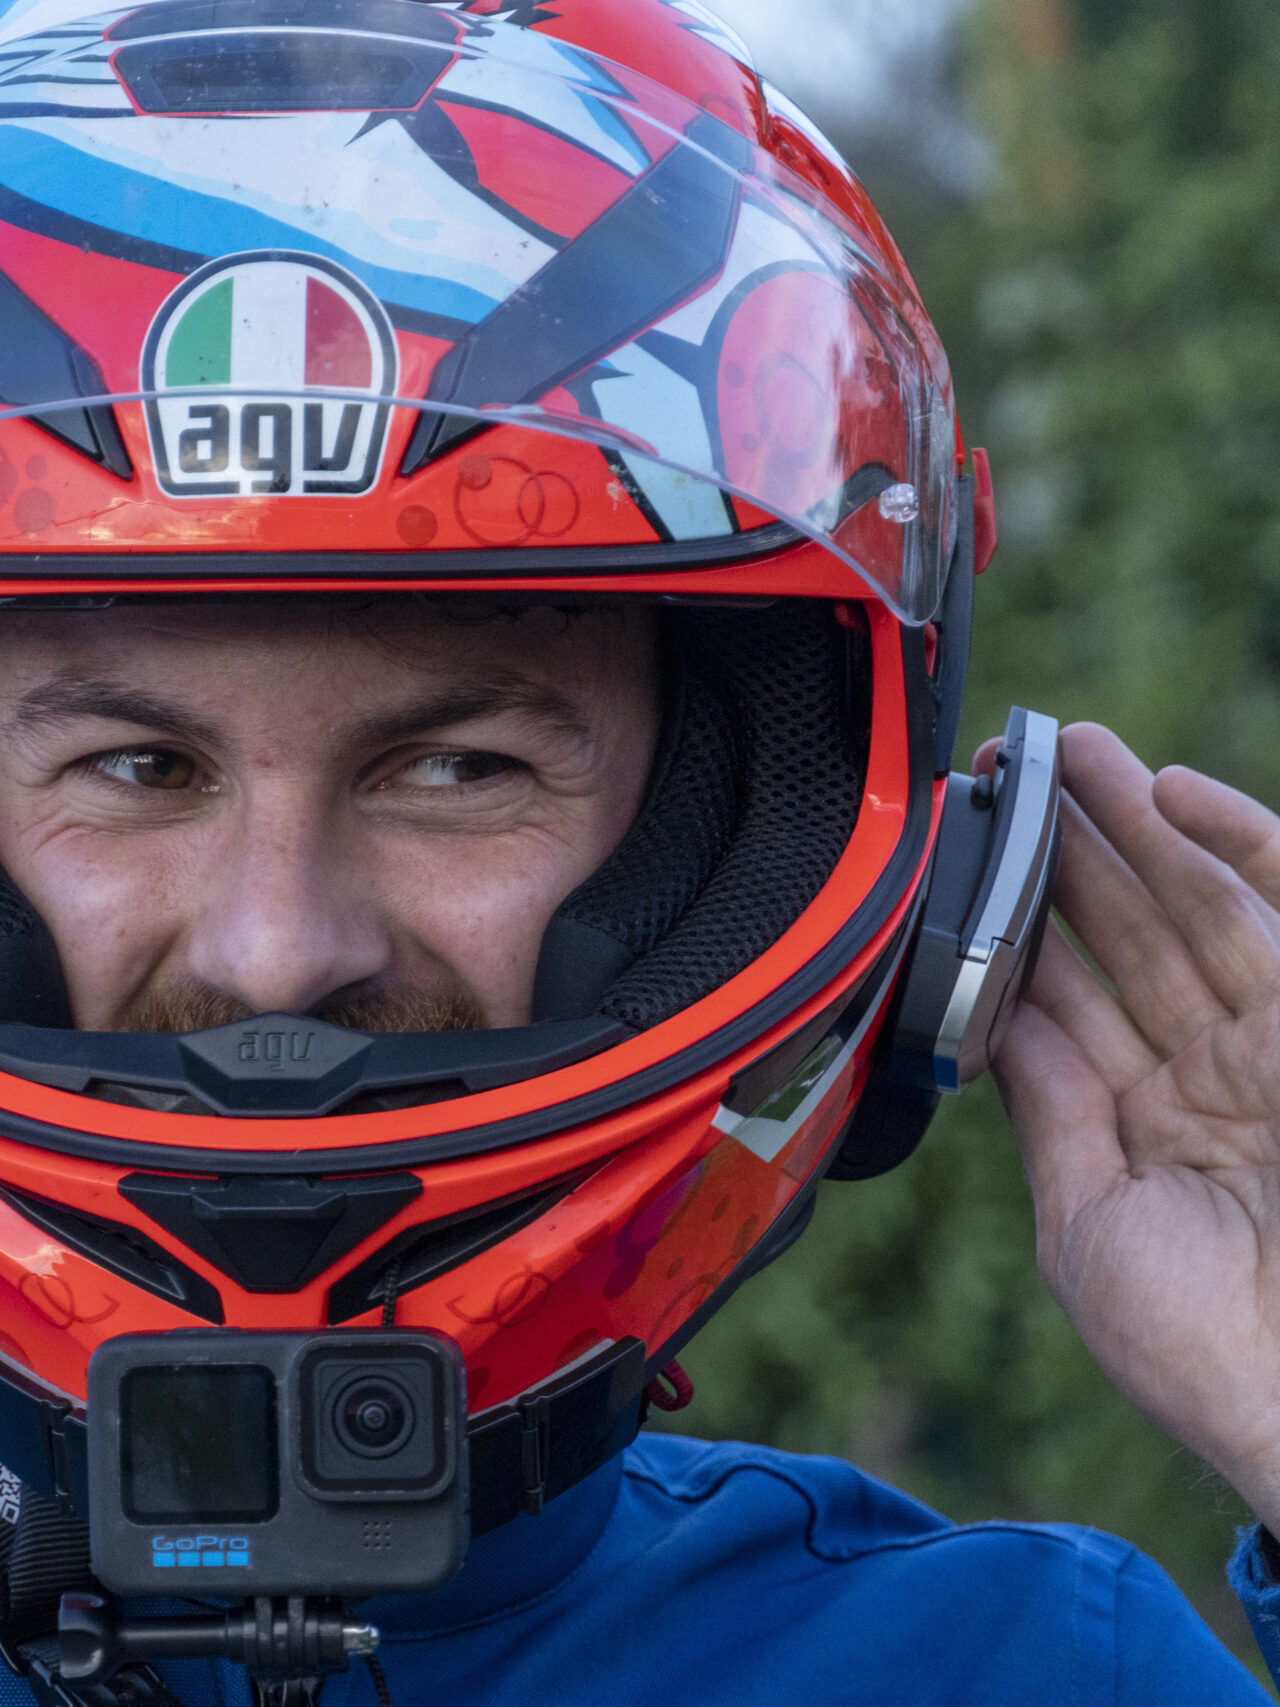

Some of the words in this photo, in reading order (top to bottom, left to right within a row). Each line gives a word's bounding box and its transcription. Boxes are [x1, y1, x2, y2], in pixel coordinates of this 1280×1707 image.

[179, 403, 363, 493] agv
[238, 1031, 317, 1072] agv
[152, 1534, 250, 1551] GoPro
